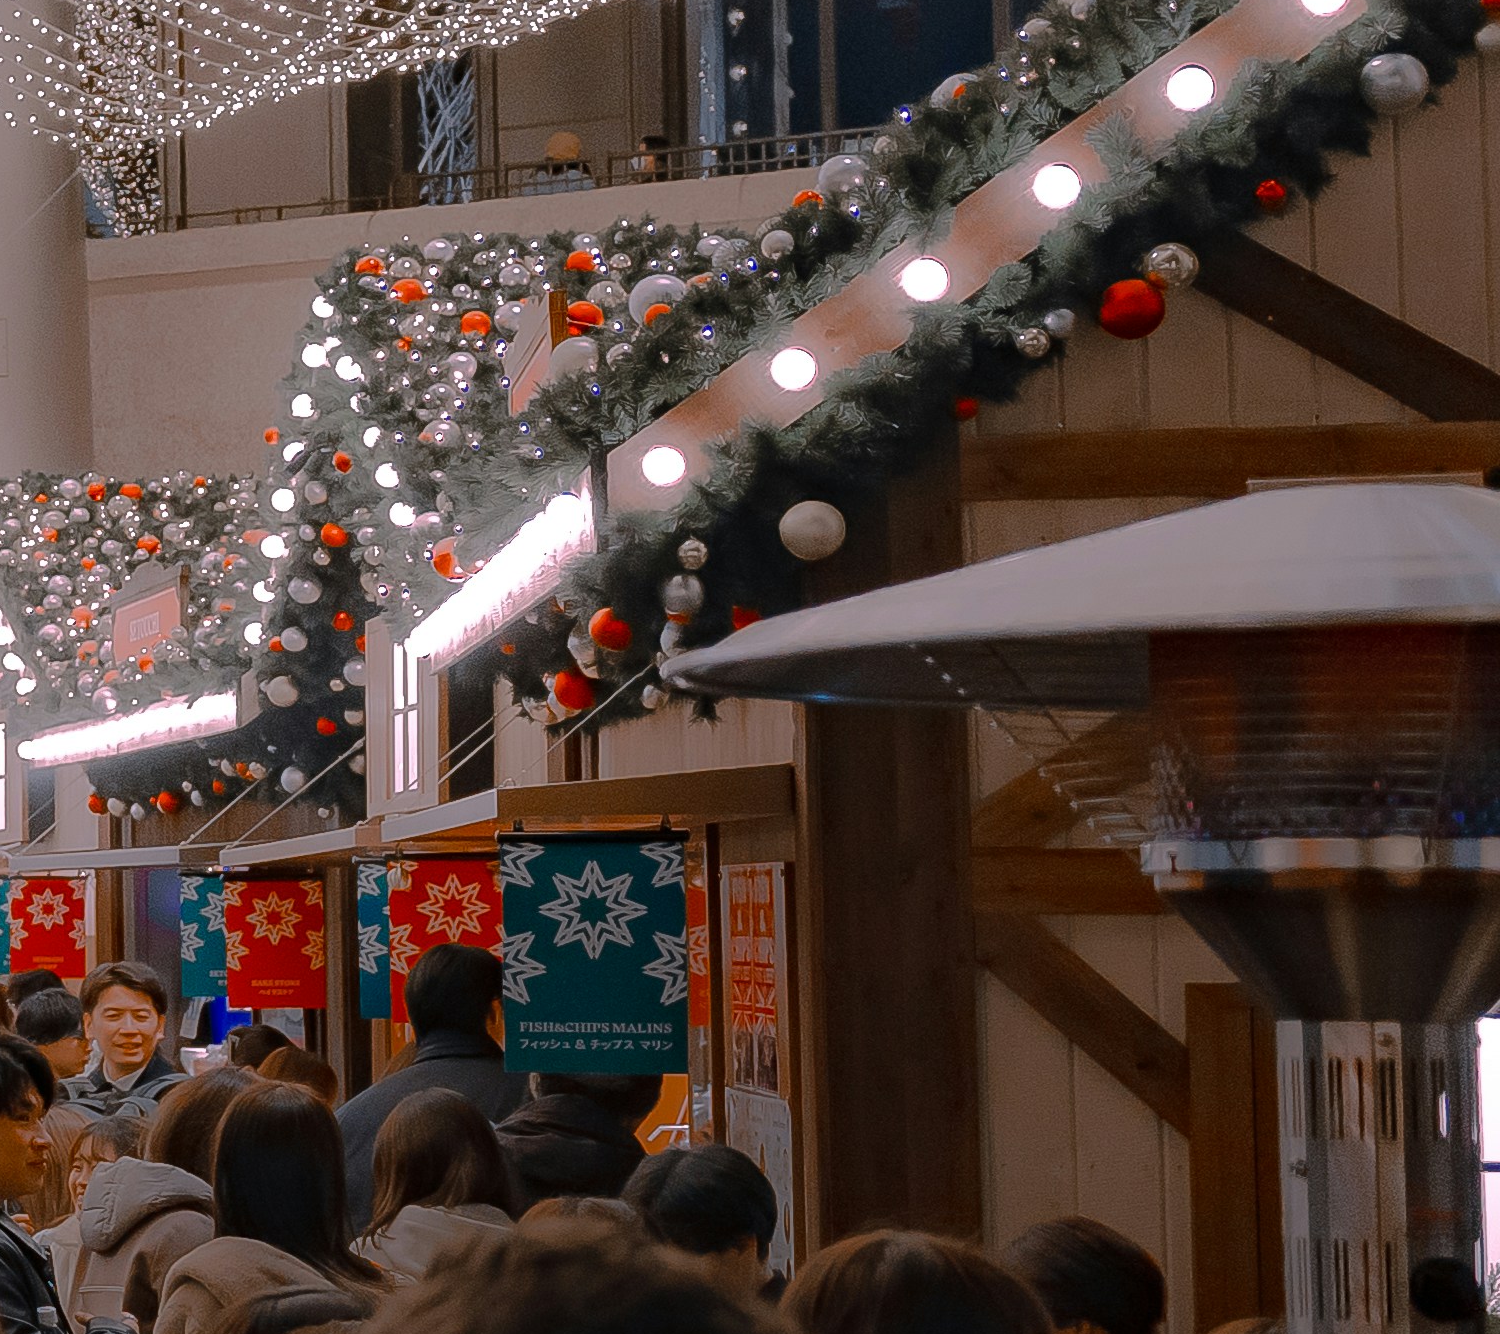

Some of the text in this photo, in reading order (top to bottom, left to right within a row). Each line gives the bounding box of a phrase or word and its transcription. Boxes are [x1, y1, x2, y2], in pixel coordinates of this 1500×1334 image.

[519, 1021, 673, 1034] FISH&CHIPS MALINS
[519, 1038, 673, 1051] フィッシュ & チップス マリン
